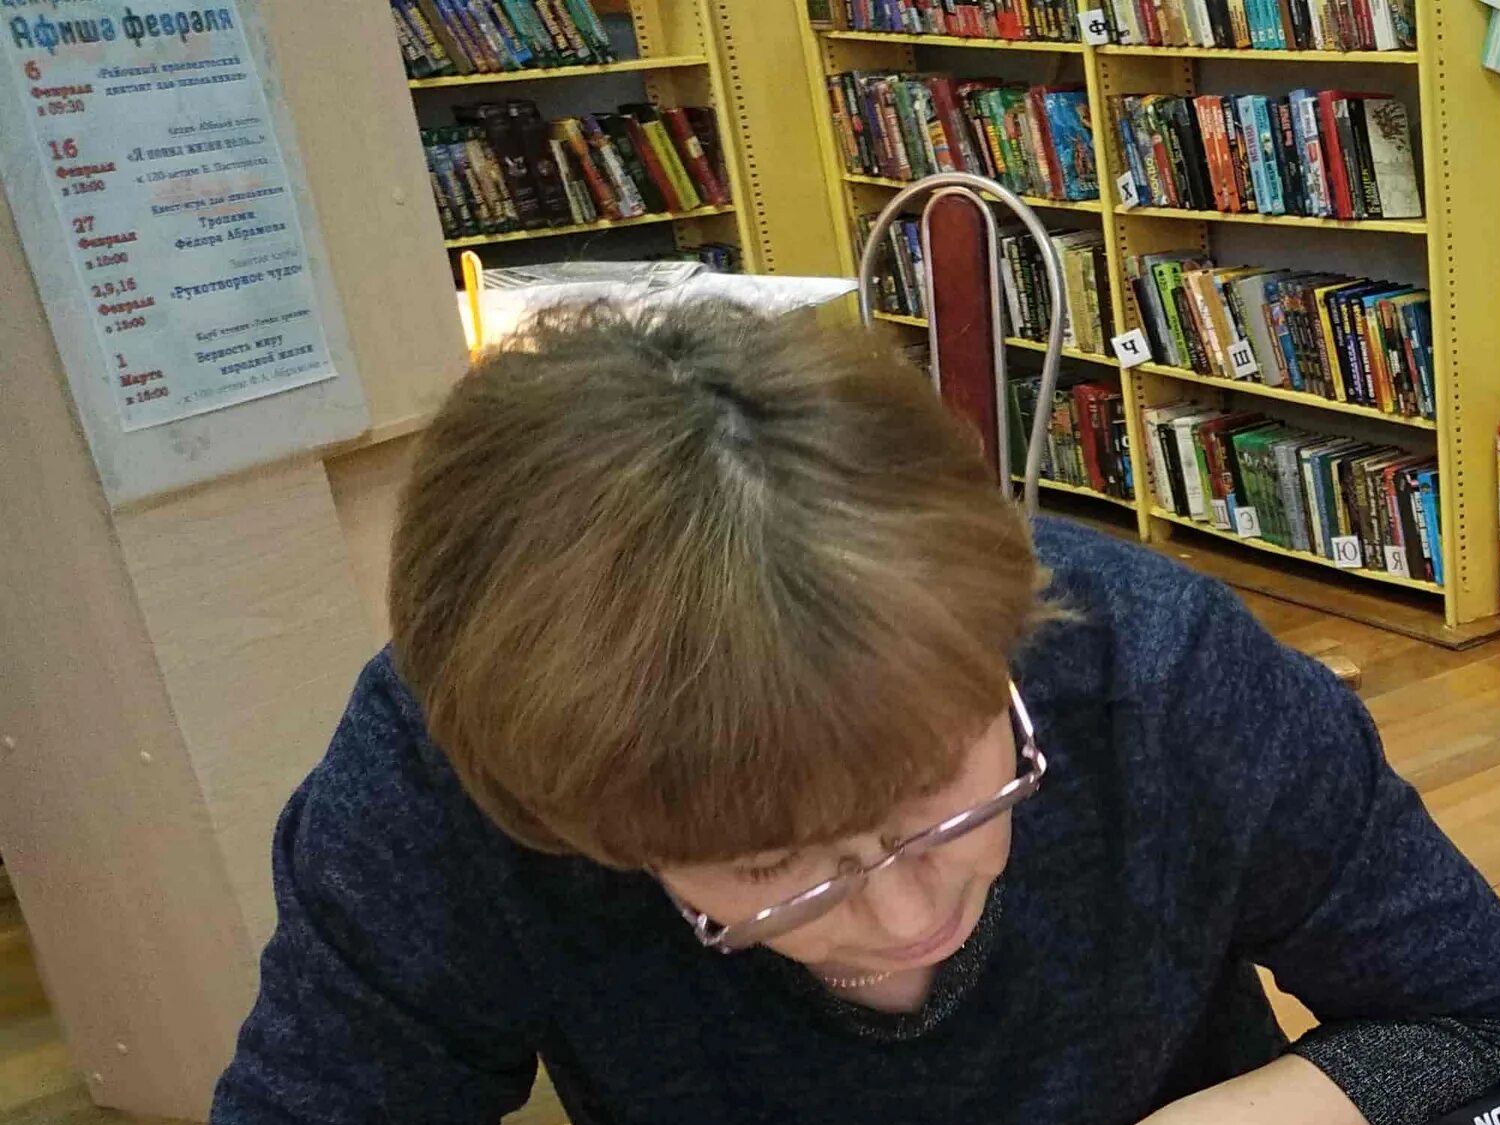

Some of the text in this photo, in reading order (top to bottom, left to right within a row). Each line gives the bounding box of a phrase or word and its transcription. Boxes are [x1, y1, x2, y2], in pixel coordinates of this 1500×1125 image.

[9, 6, 234, 55] Афиша февраля
[49, 138, 78, 160] 16
[1122, 339, 1139, 355] Ч
[1232, 350, 1250, 368] Ш
[1240, 511, 1254, 531] Э
[1336, 541, 1358, 562] Ю
[1392, 552, 1404, 571] Я
